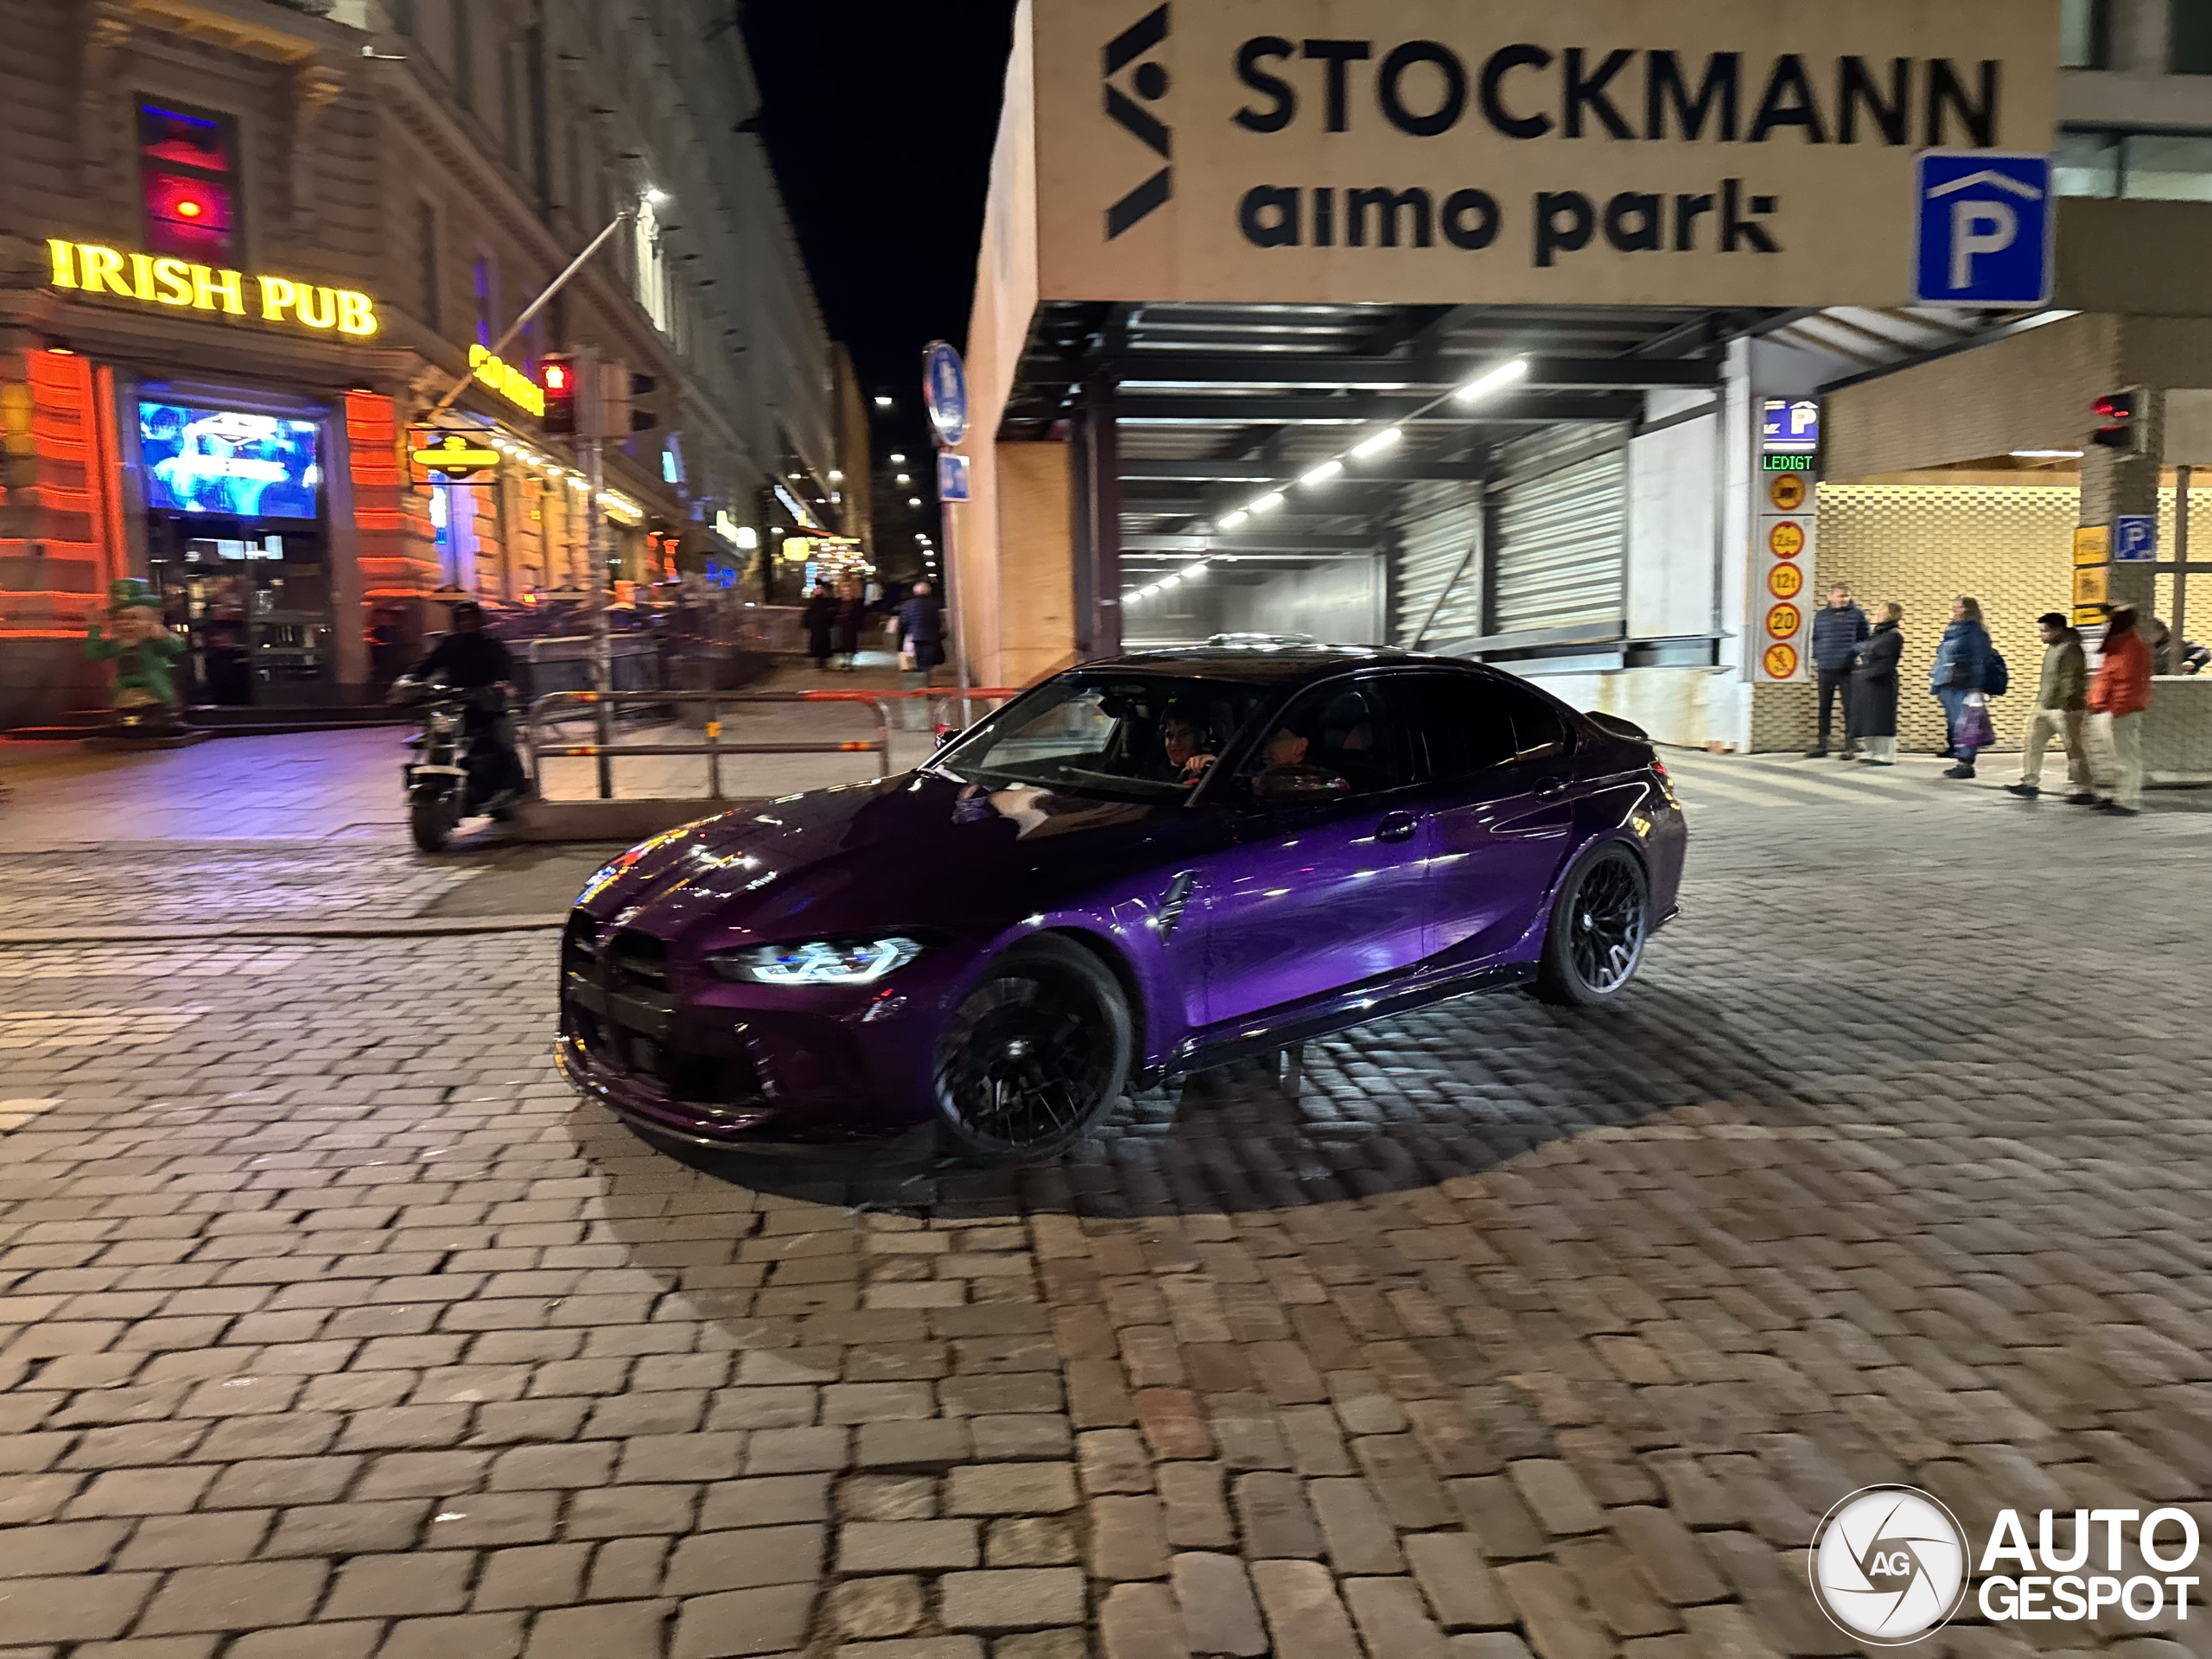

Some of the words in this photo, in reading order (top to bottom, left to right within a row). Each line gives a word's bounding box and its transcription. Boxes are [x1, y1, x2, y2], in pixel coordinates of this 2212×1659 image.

[1233, 35, 1999, 149] STOCKMANN
[1238, 183, 1503, 251] aimo
[1531, 178, 1783, 268] park
[1949, 200, 2018, 290] P
[47, 238, 247, 316] IRISH
[259, 275, 378, 337] PUB
[1763, 455, 1814, 470] LEDIGT
[1790, 408, 1817, 435] P
[1772, 612, 1796, 630] 20
